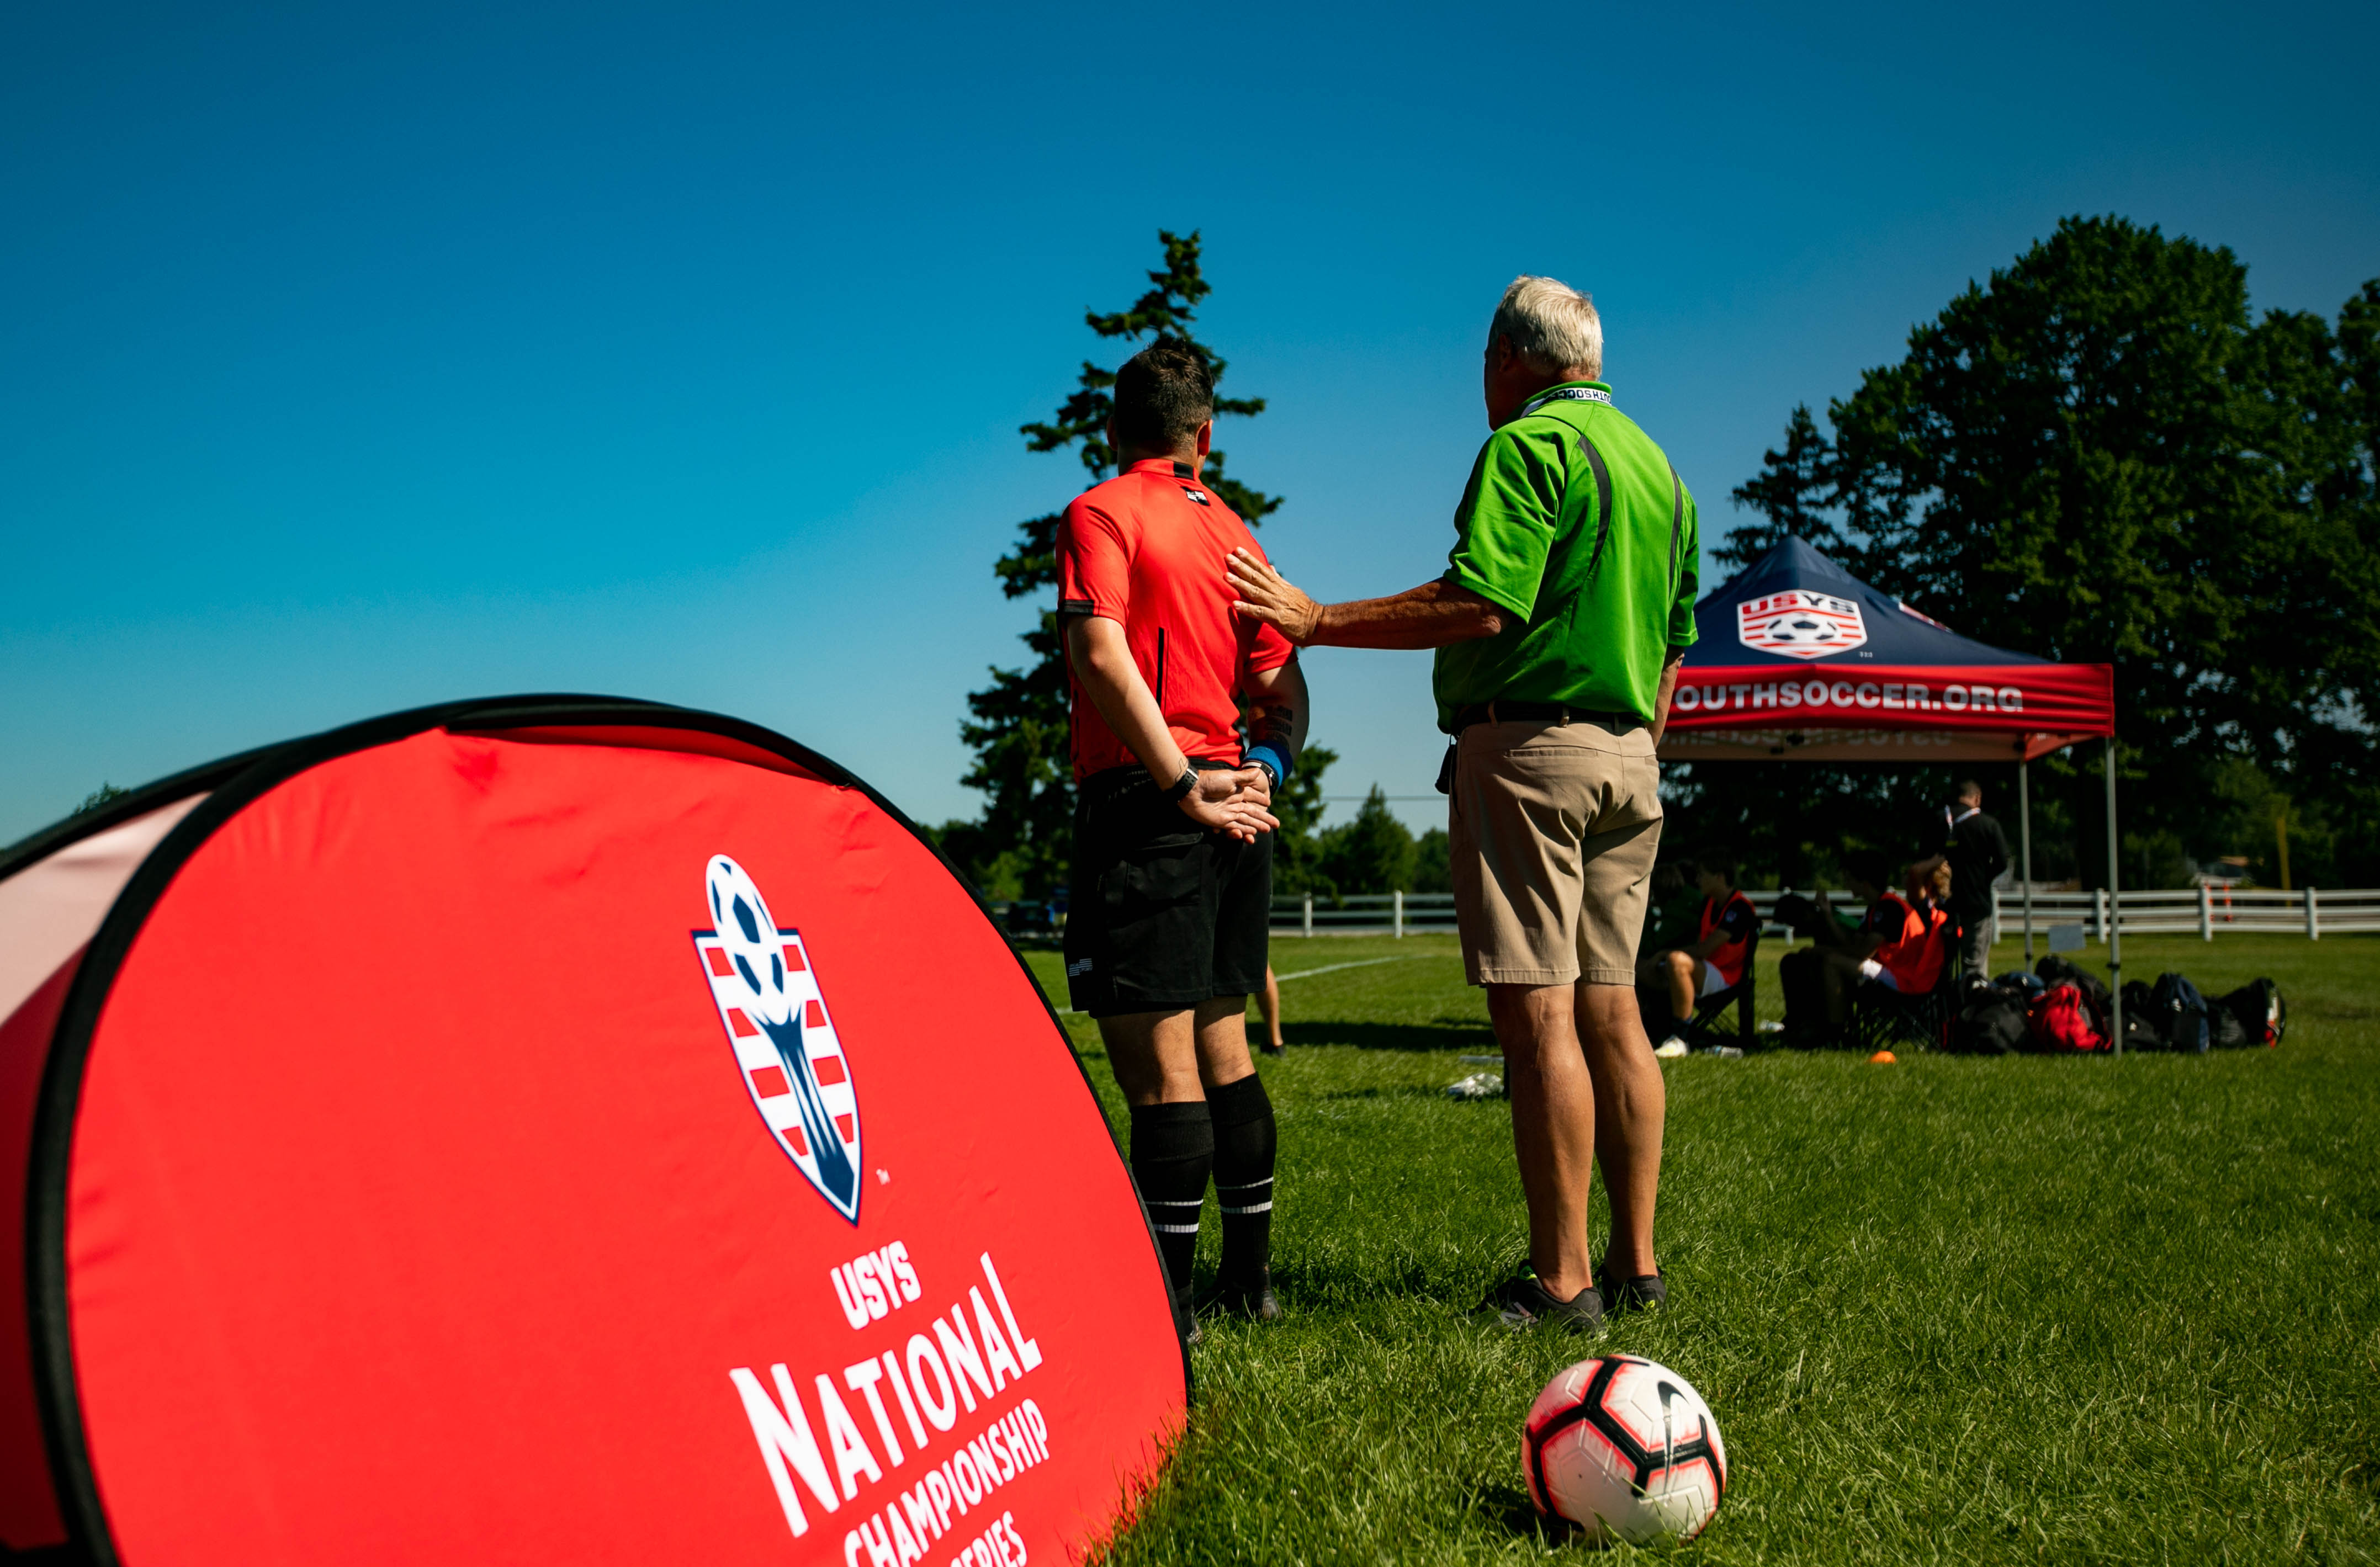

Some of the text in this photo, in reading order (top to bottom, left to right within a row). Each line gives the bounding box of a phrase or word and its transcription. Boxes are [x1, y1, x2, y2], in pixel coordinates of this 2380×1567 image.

[1742, 593, 1854, 613] USYS
[1675, 679, 2023, 713] OUTHSOCCER.ORG
[830, 1240, 921, 1330] USYS
[729, 1250, 1043, 1538] NATIONAL
[844, 1398, 1049, 1567] CHAMPIONSHIP
[950, 1510, 1028, 1567] RIES
